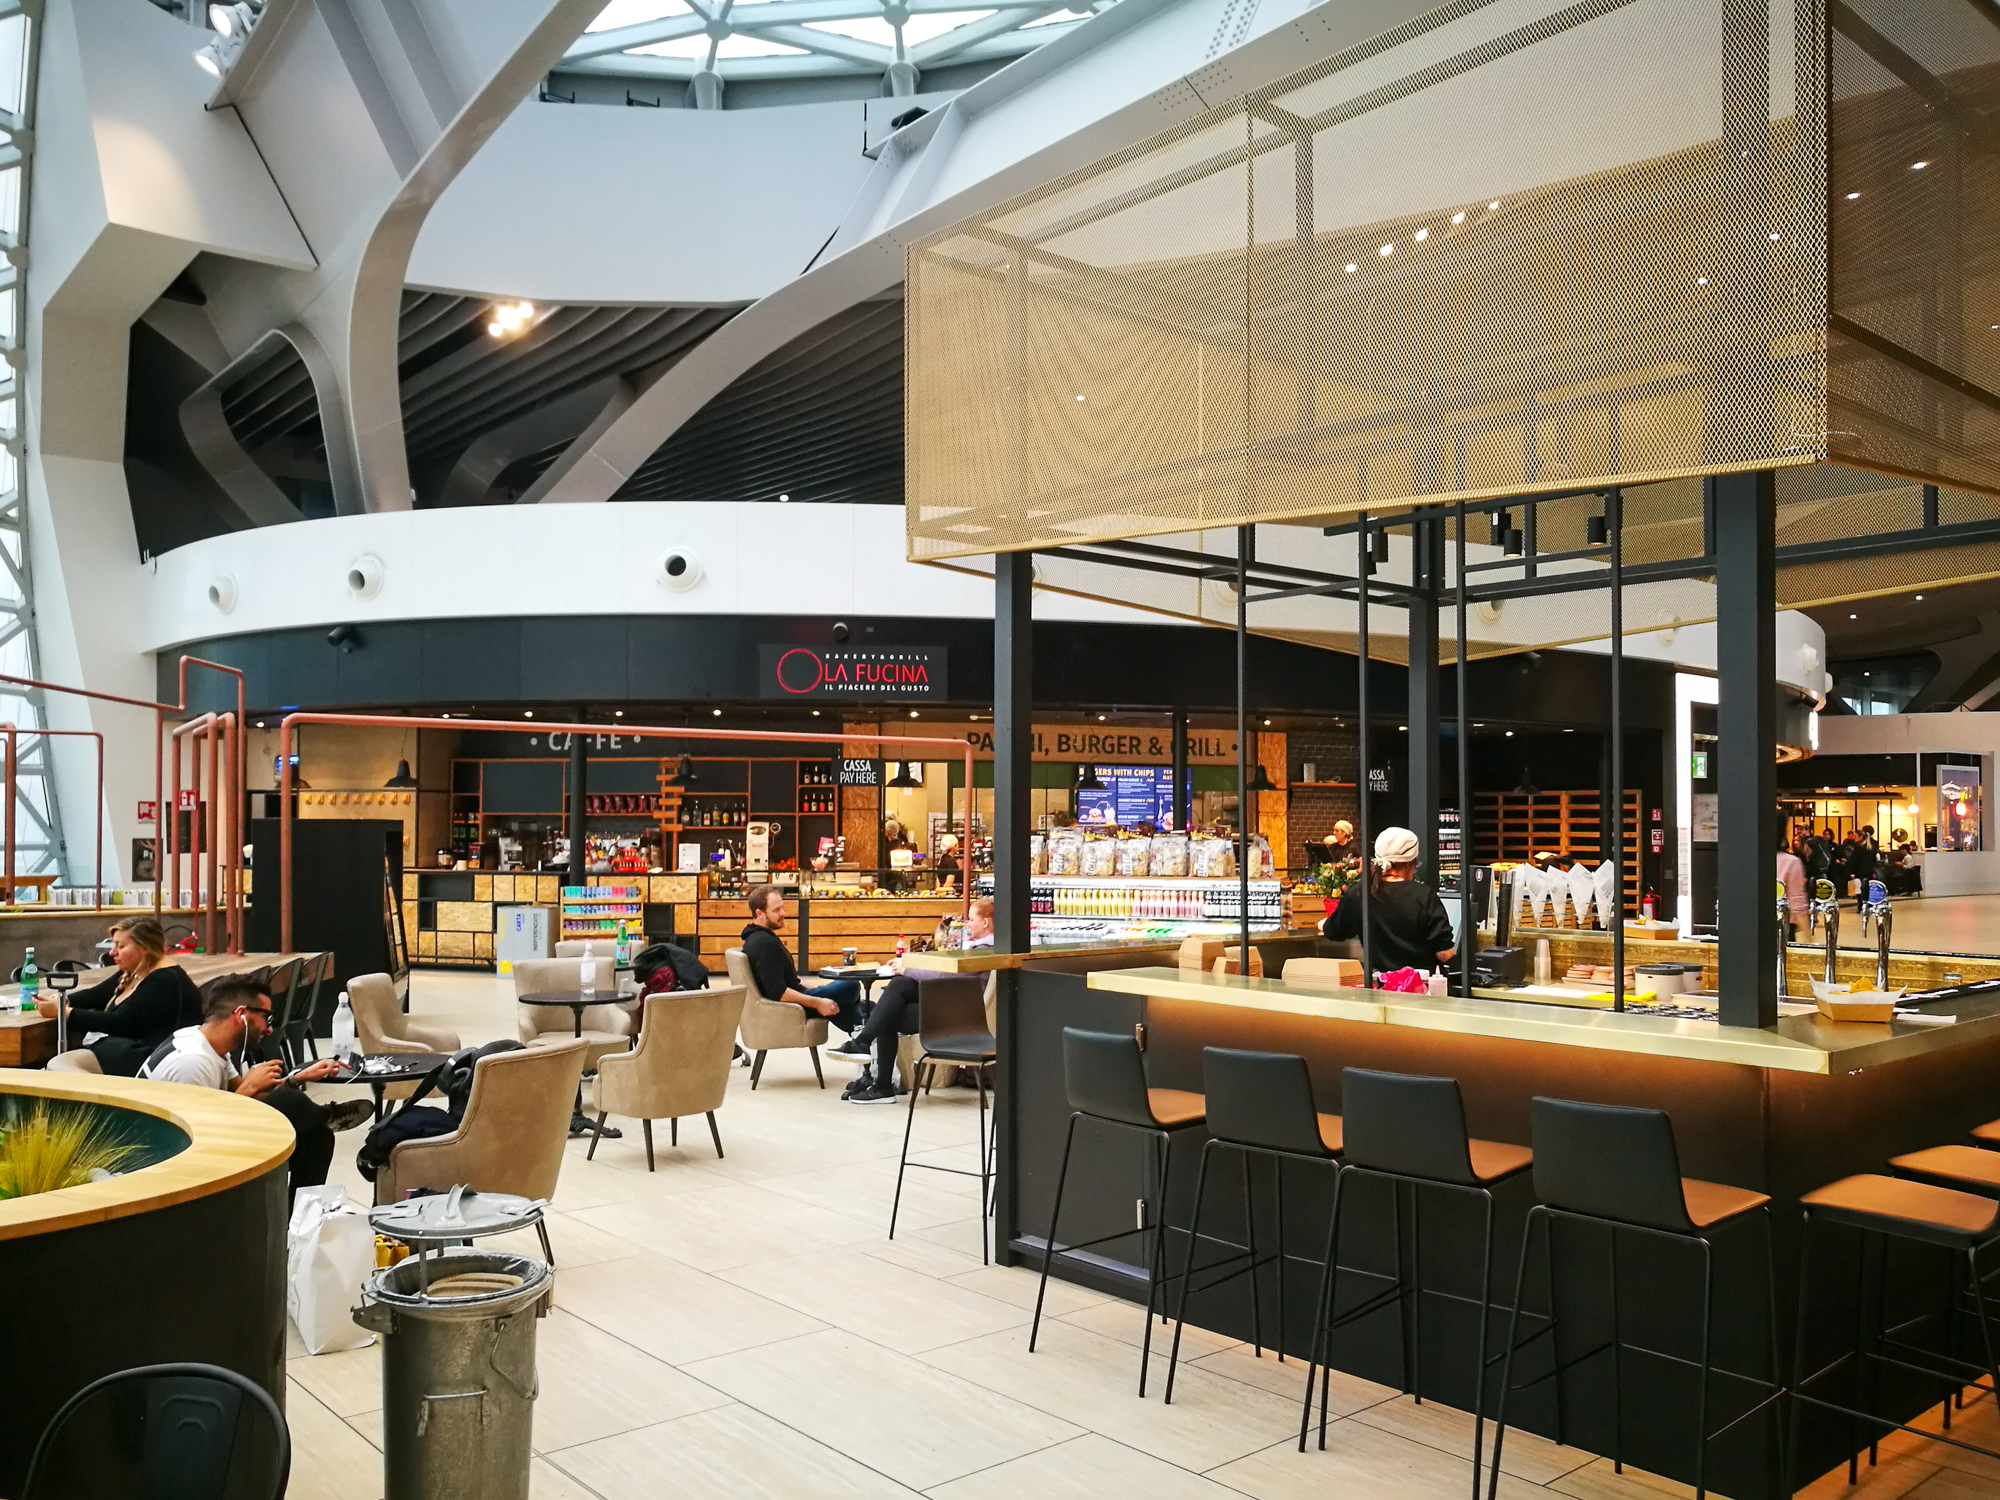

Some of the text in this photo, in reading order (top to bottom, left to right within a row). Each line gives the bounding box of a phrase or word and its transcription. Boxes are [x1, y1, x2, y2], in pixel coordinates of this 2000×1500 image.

[824, 664, 928, 683] LA FUCINA
[1057, 734, 1142, 755] BURGER
[1148, 736, 1164, 756] &
[1170, 737, 1226, 756] RILL
[843, 759, 872, 772] CASSA
[1079, 767, 1112, 776] BGERS
[1113, 768, 1132, 776] WITH
[1134, 769, 1155, 777] CHIPS
[840, 771, 877, 784] PAY HERE
[1368, 769, 1385, 780] ASSA
